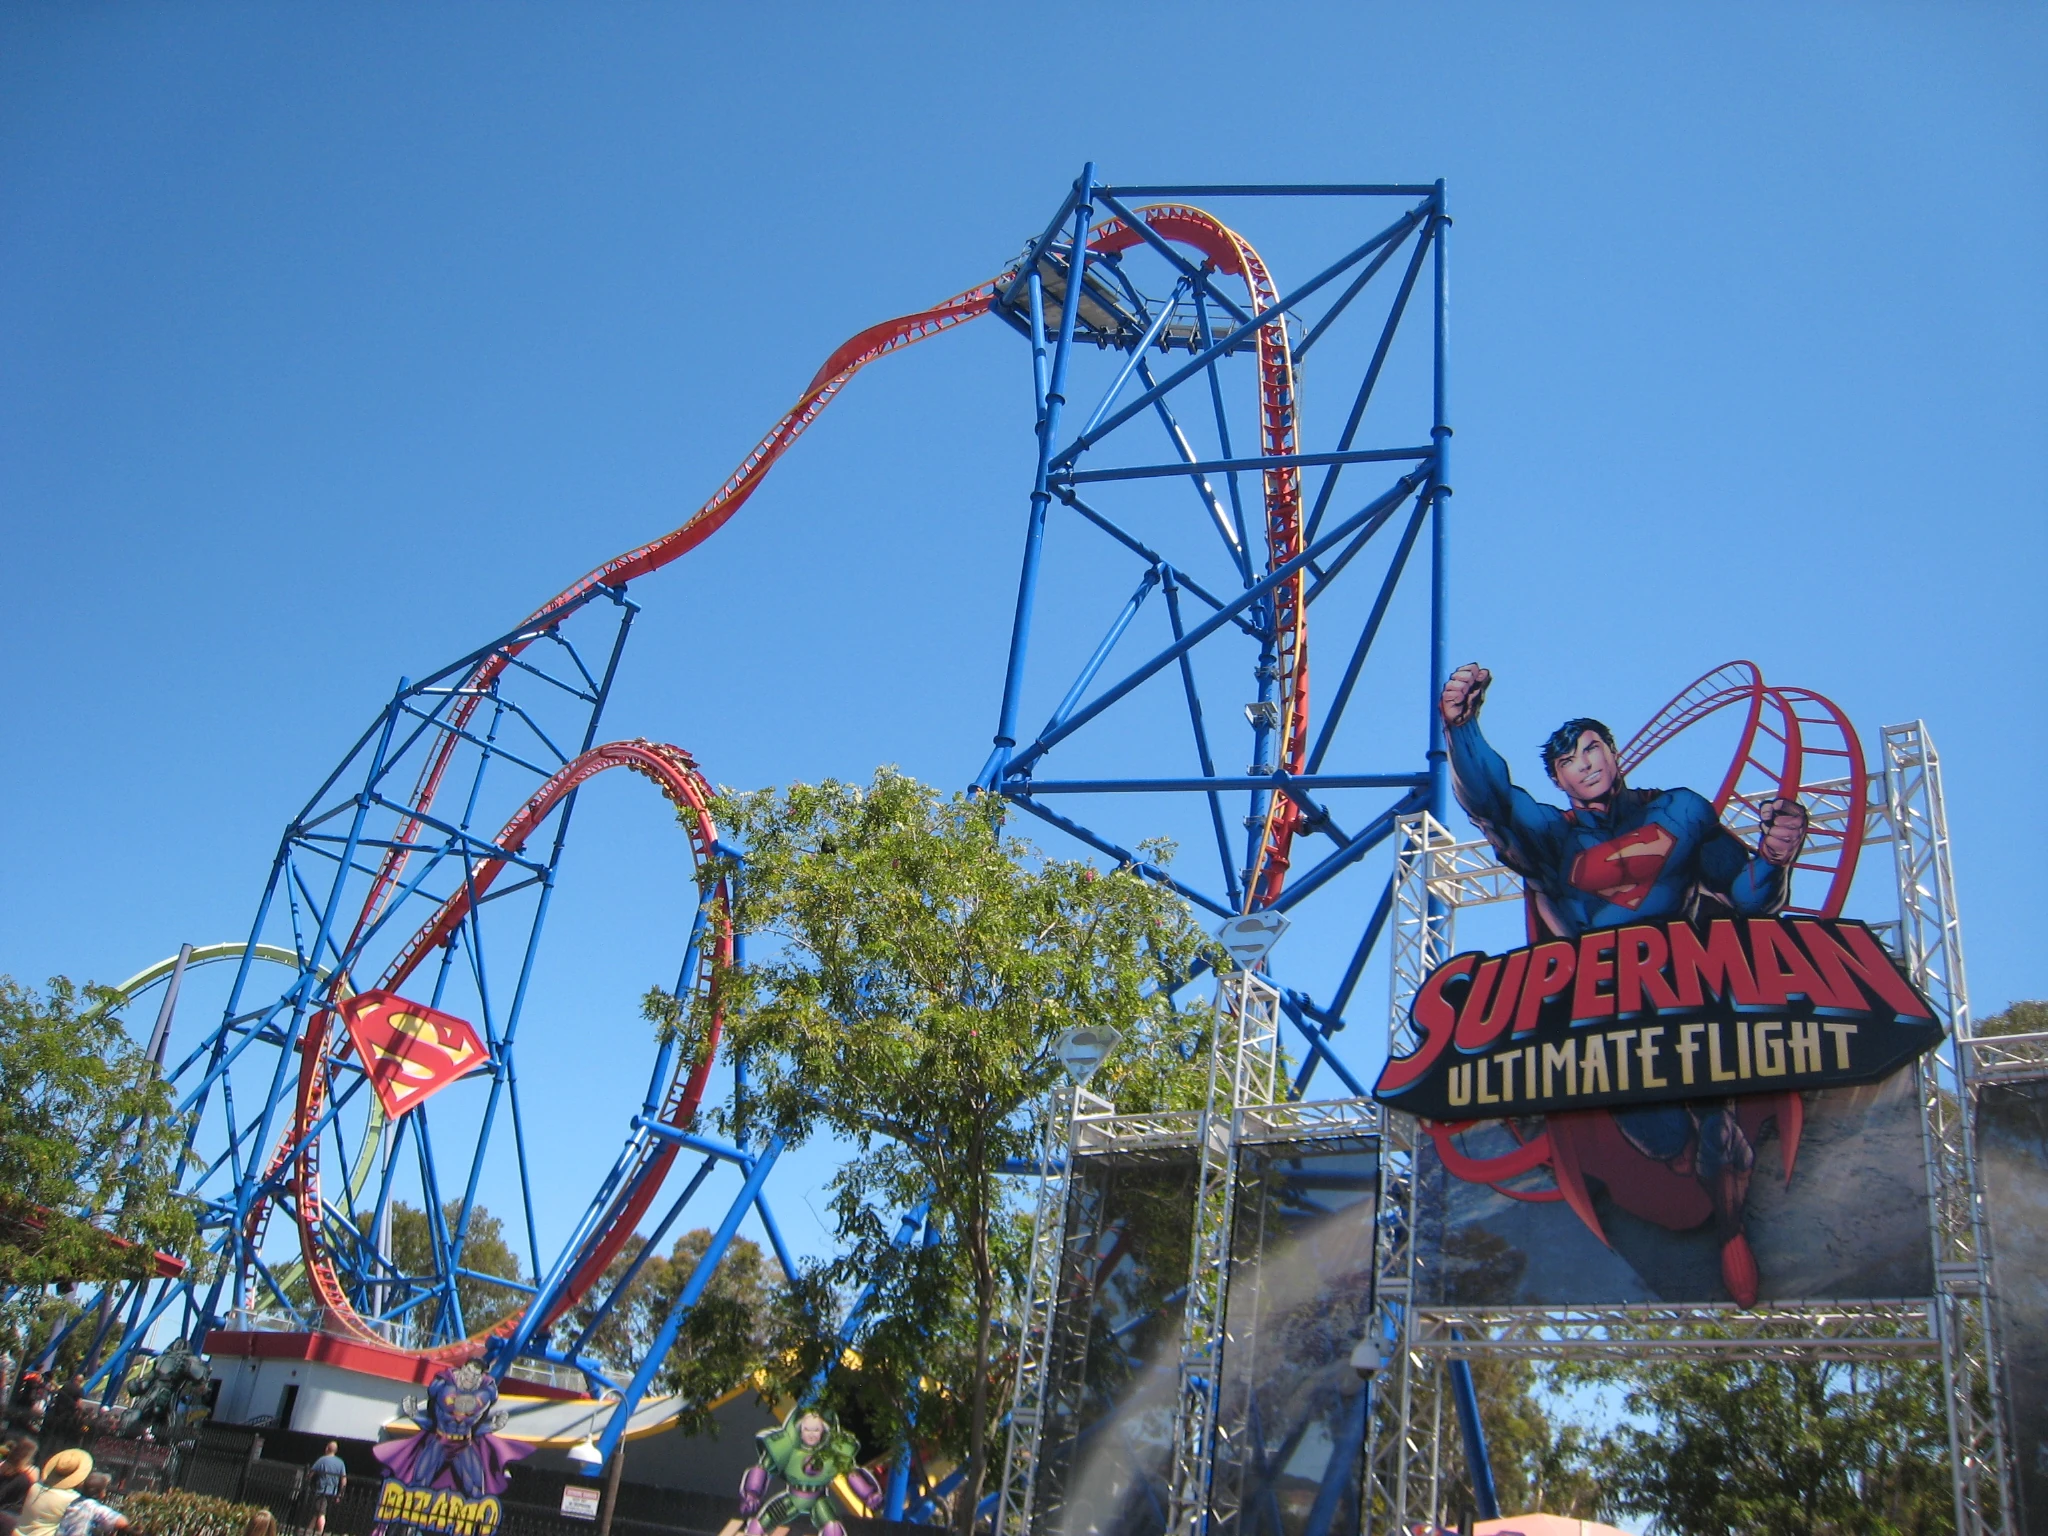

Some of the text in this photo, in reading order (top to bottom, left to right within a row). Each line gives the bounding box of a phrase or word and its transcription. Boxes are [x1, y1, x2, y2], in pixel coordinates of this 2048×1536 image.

[346, 997, 480, 1098] S
[1375, 919, 1932, 1098] SUPERMAN
[1448, 1021, 1859, 1107] ULTIMATE FLIGHT
